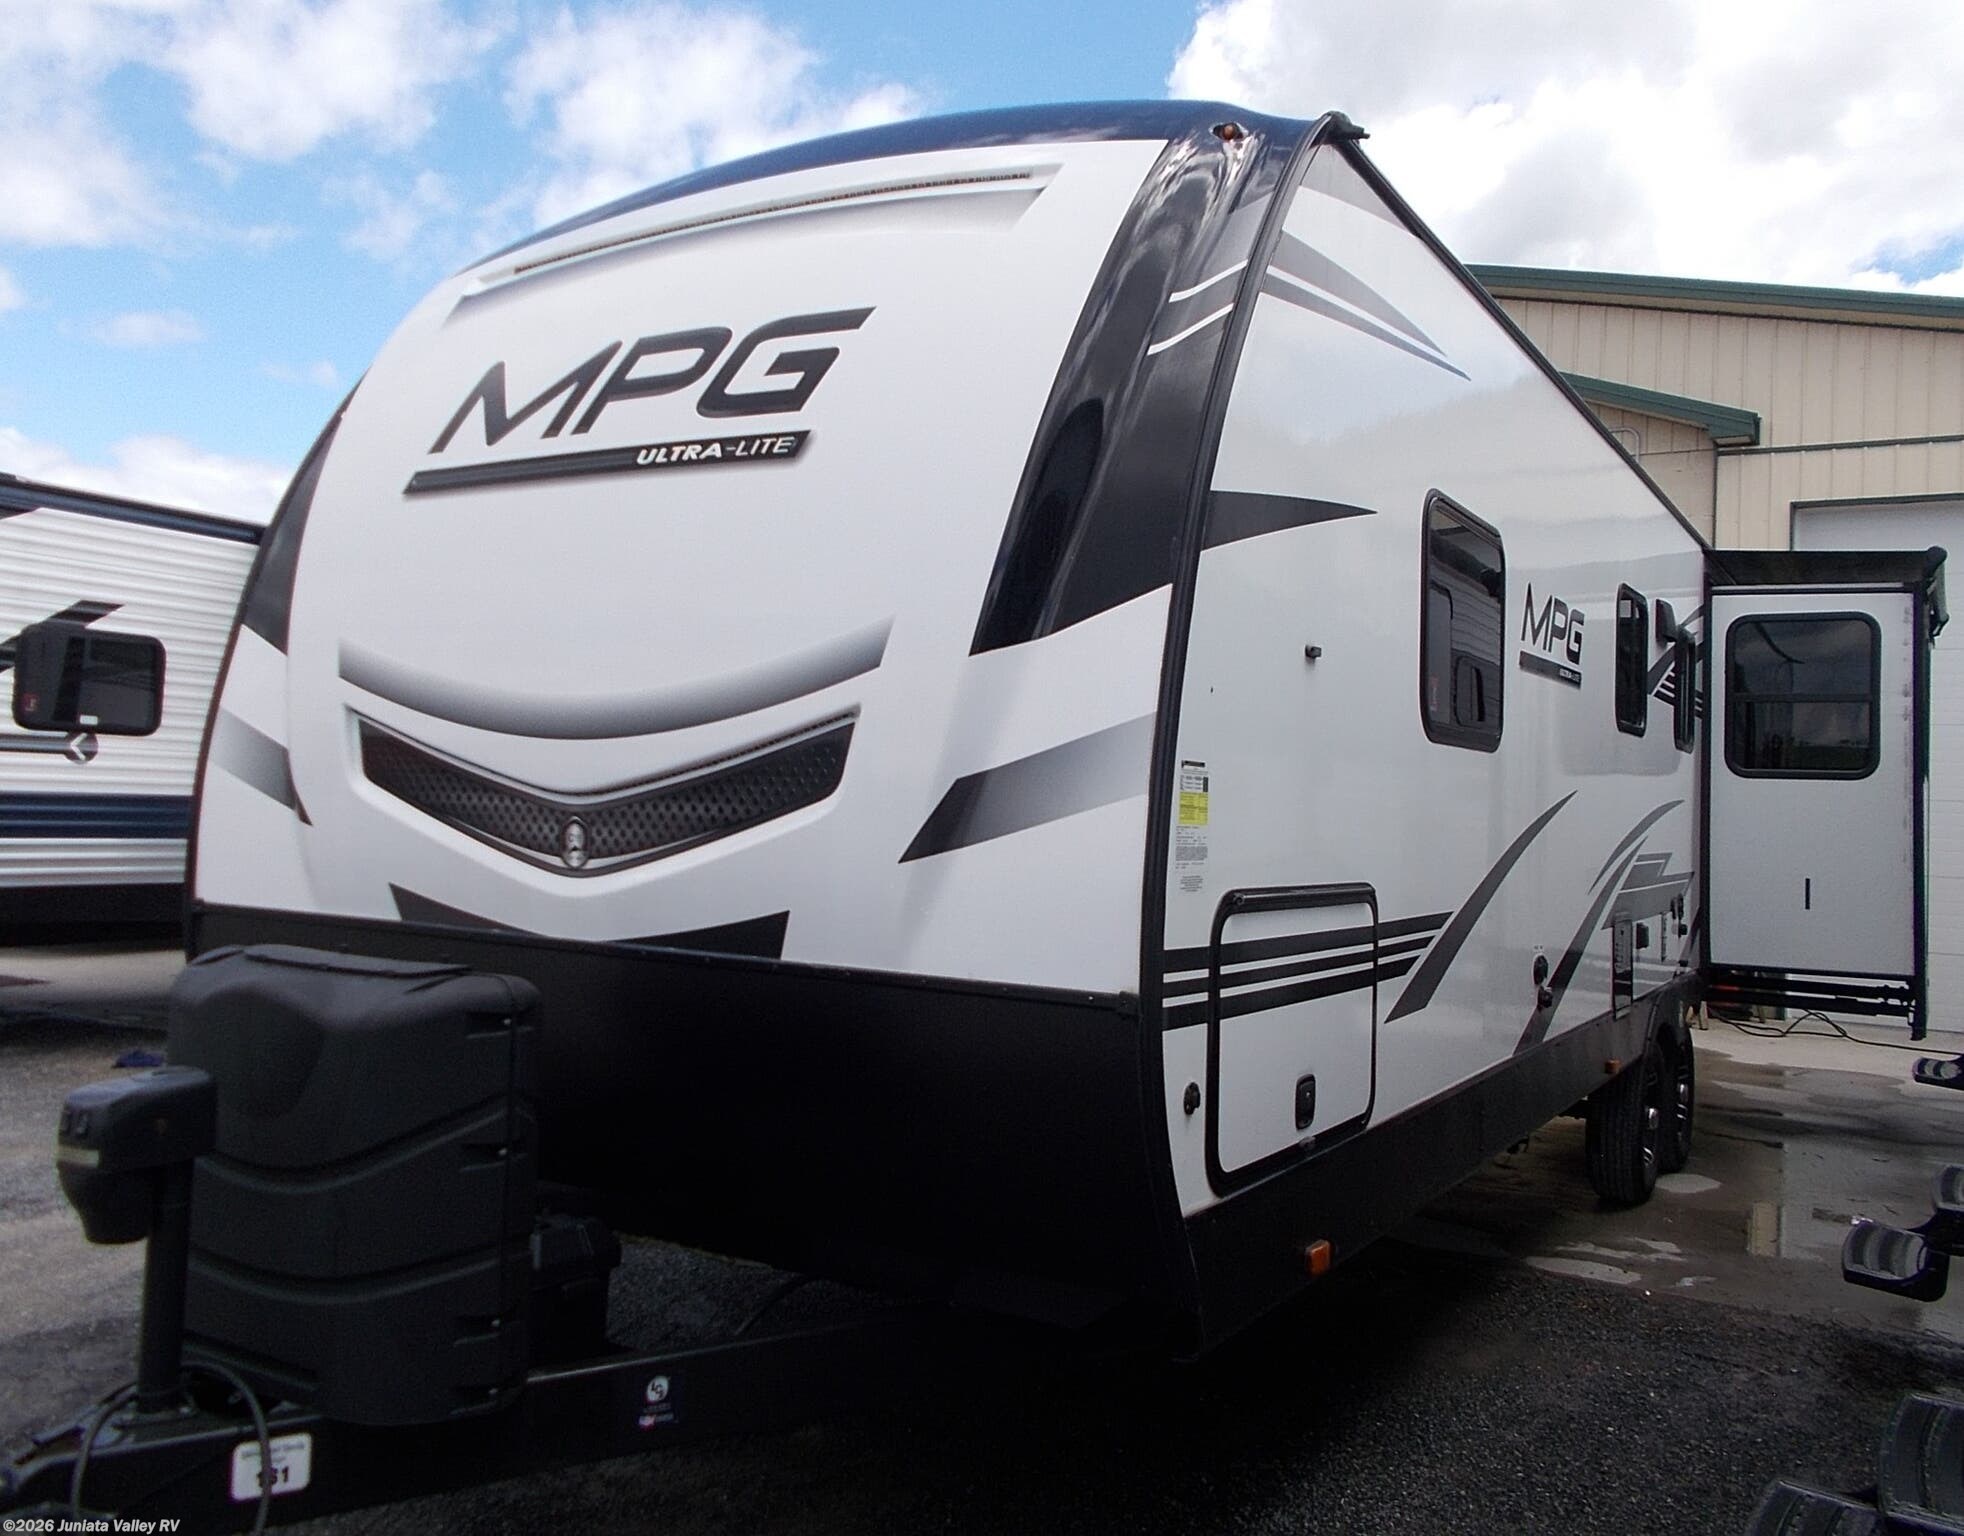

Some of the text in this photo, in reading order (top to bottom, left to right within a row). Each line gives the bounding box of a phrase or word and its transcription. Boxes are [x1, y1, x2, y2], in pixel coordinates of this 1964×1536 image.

[428, 306, 877, 454] MPG
[636, 436, 796, 465] ULTRA-LITE
[1520, 581, 1585, 666] MPG
